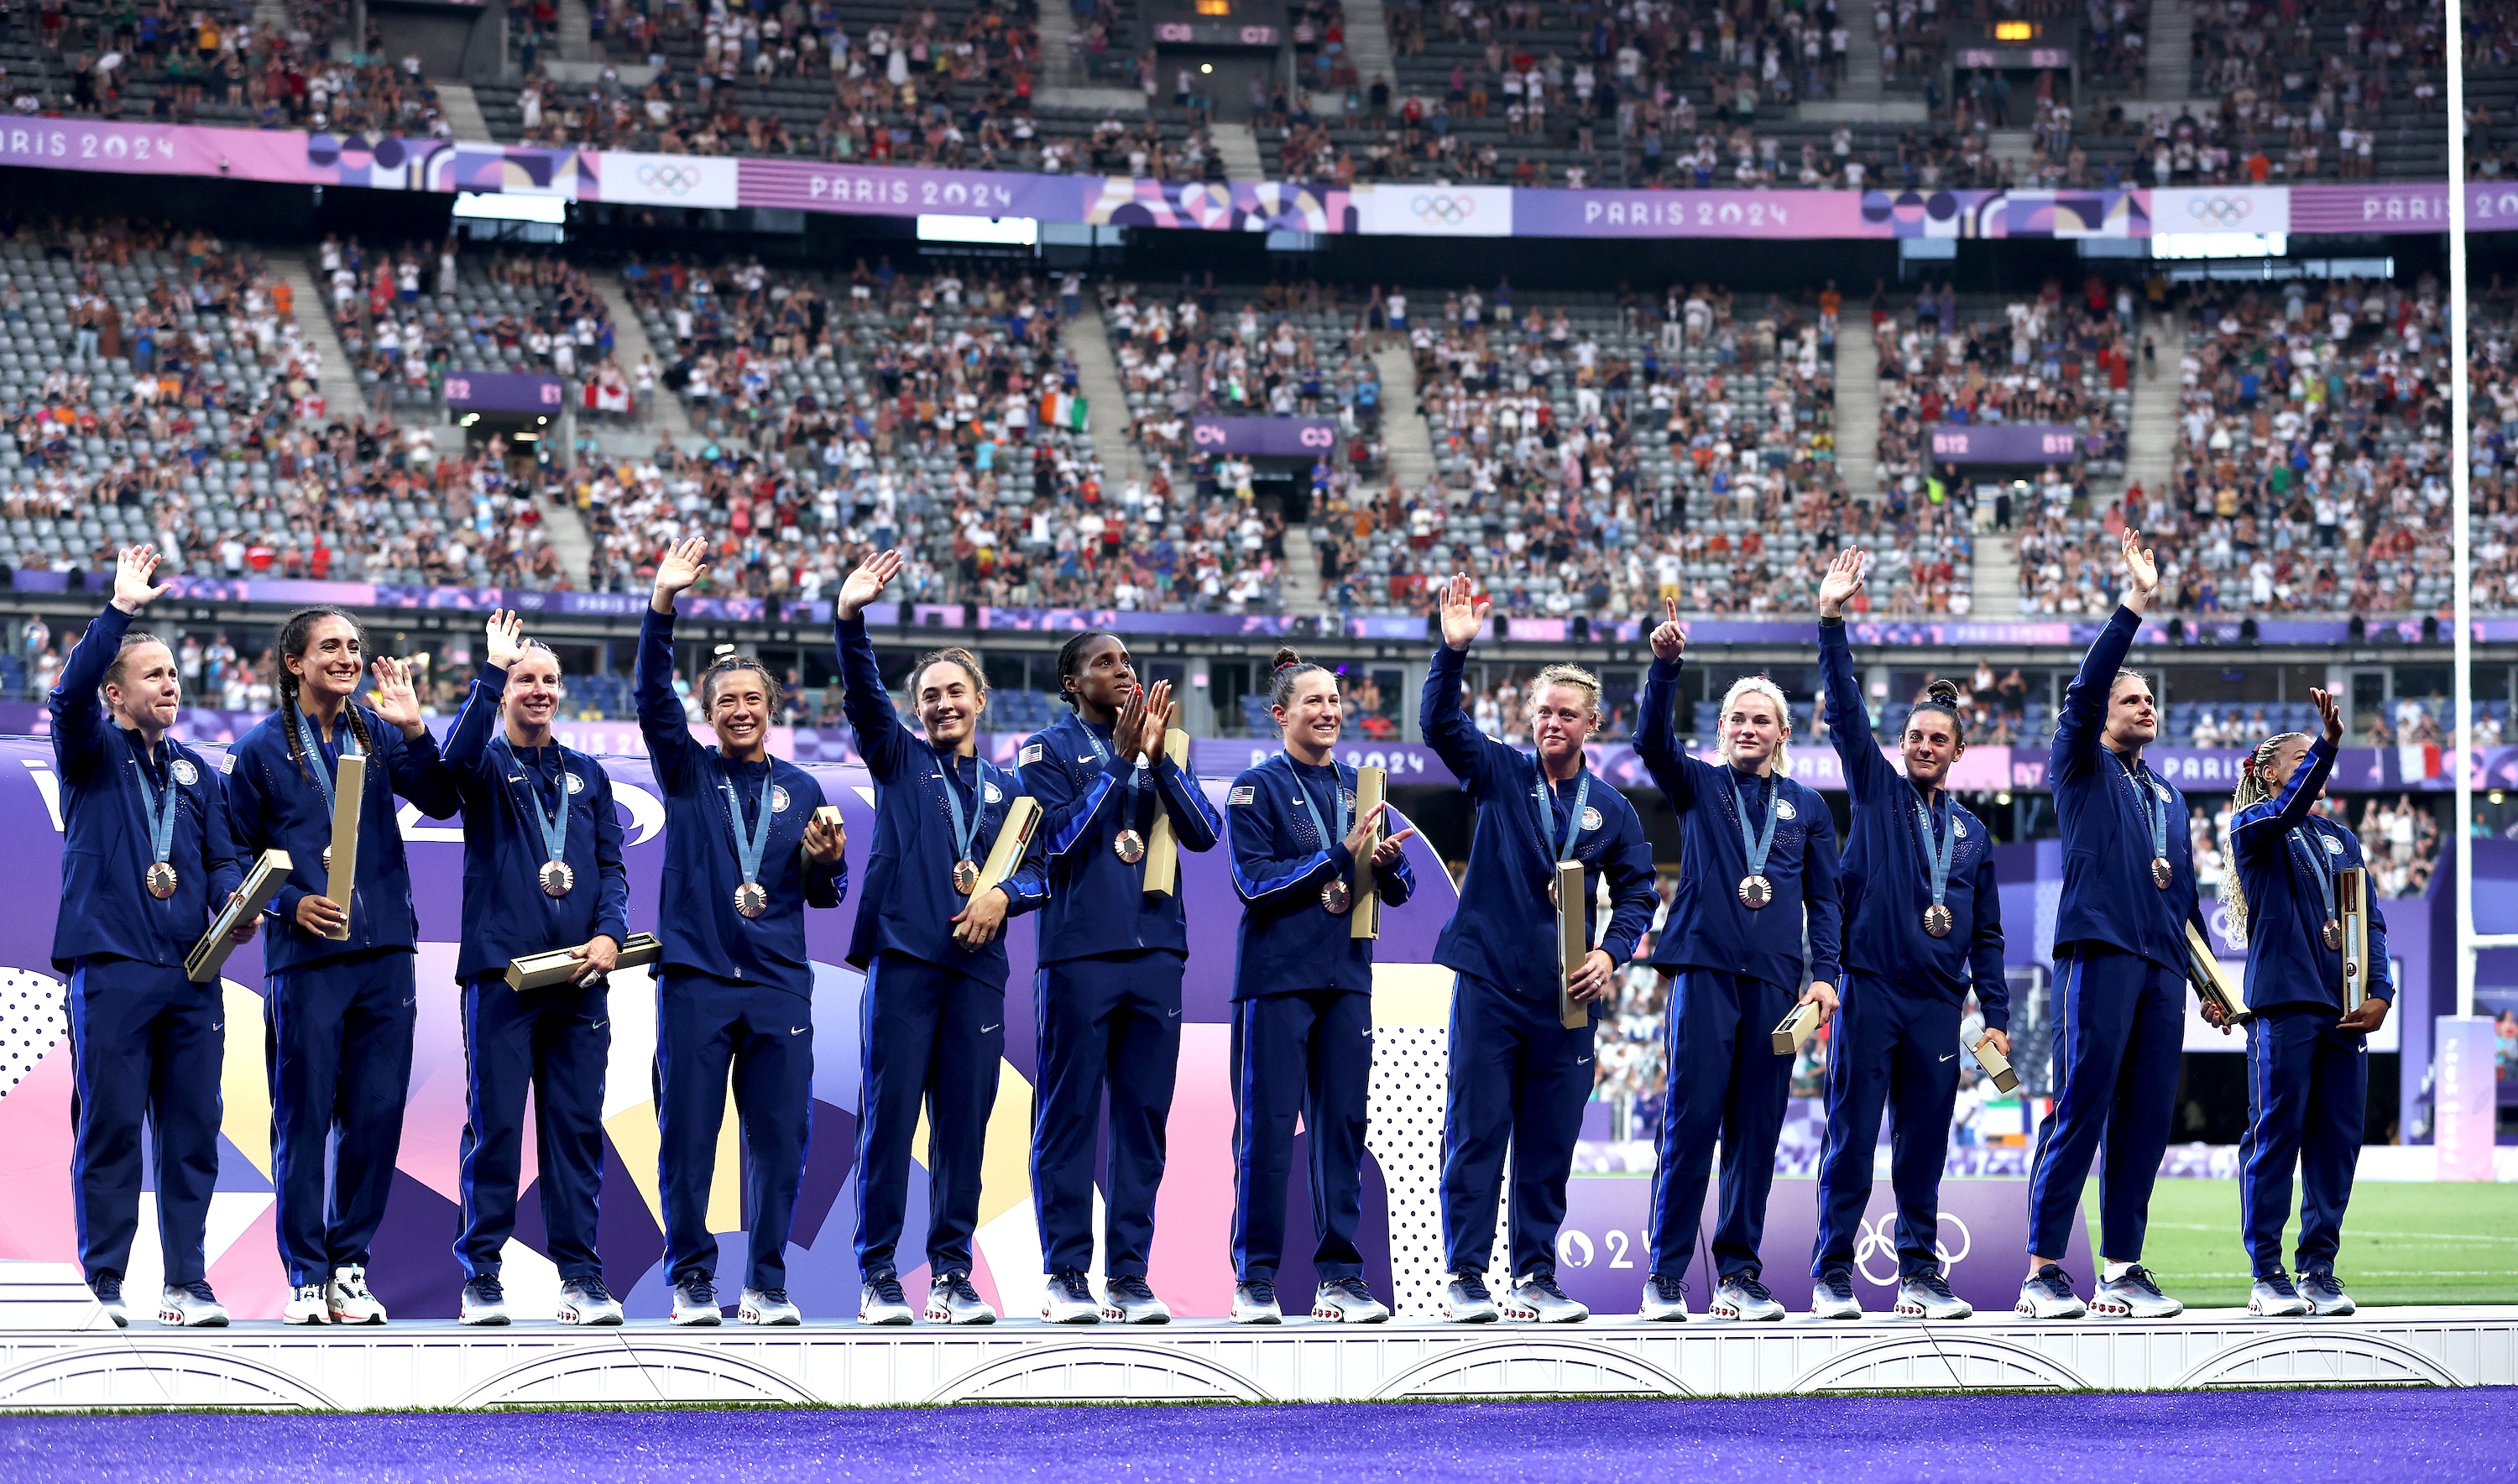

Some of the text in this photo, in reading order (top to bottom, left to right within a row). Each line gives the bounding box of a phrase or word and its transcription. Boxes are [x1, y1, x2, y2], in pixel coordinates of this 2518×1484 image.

[0, 128, 175, 159] RIS 2024
[809, 175, 1012, 207] PARIS 2024
[1585, 200, 1788, 227] PARIS 2024
[2363, 196, 2449, 222] PARI
[299, 725, 317, 760] PARIS 2024
[1346, 750, 1424, 774] 2024
